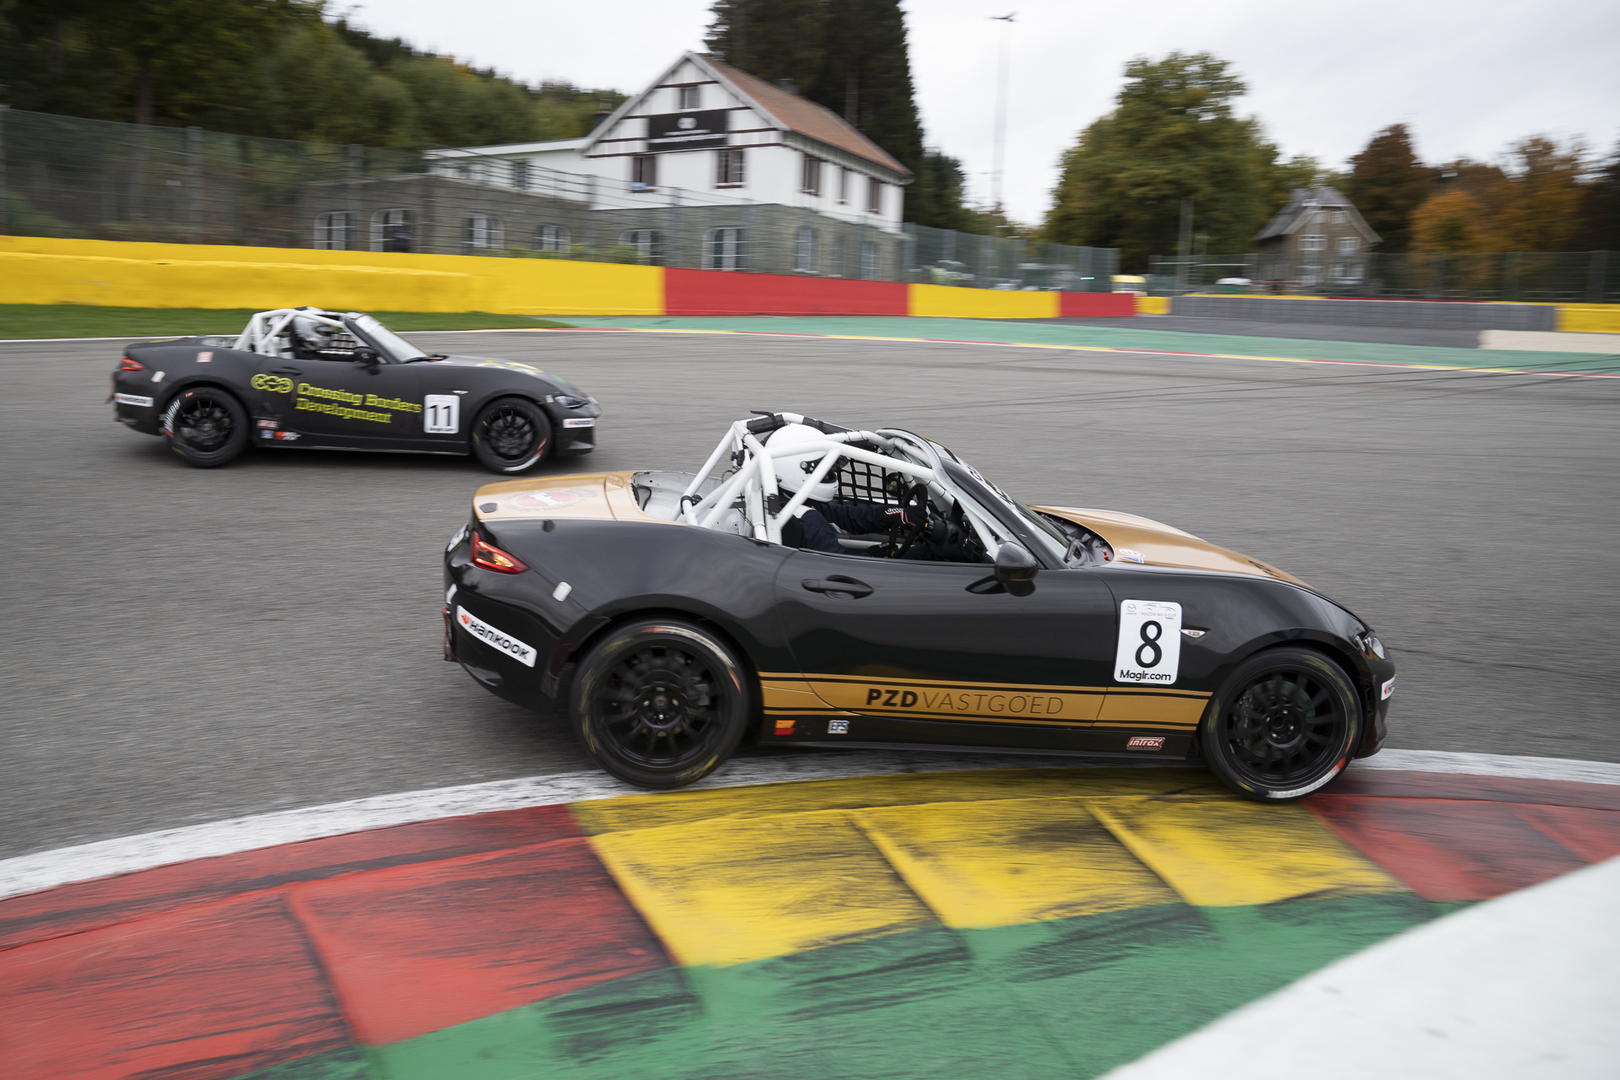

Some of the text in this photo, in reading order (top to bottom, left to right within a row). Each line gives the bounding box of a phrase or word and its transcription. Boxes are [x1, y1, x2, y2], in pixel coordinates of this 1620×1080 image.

[295, 397, 393, 424] Development
[428, 404, 452, 427] 11
[1135, 620, 1163, 669] 8
[865, 688, 1064, 715] PZD VASTGOED
